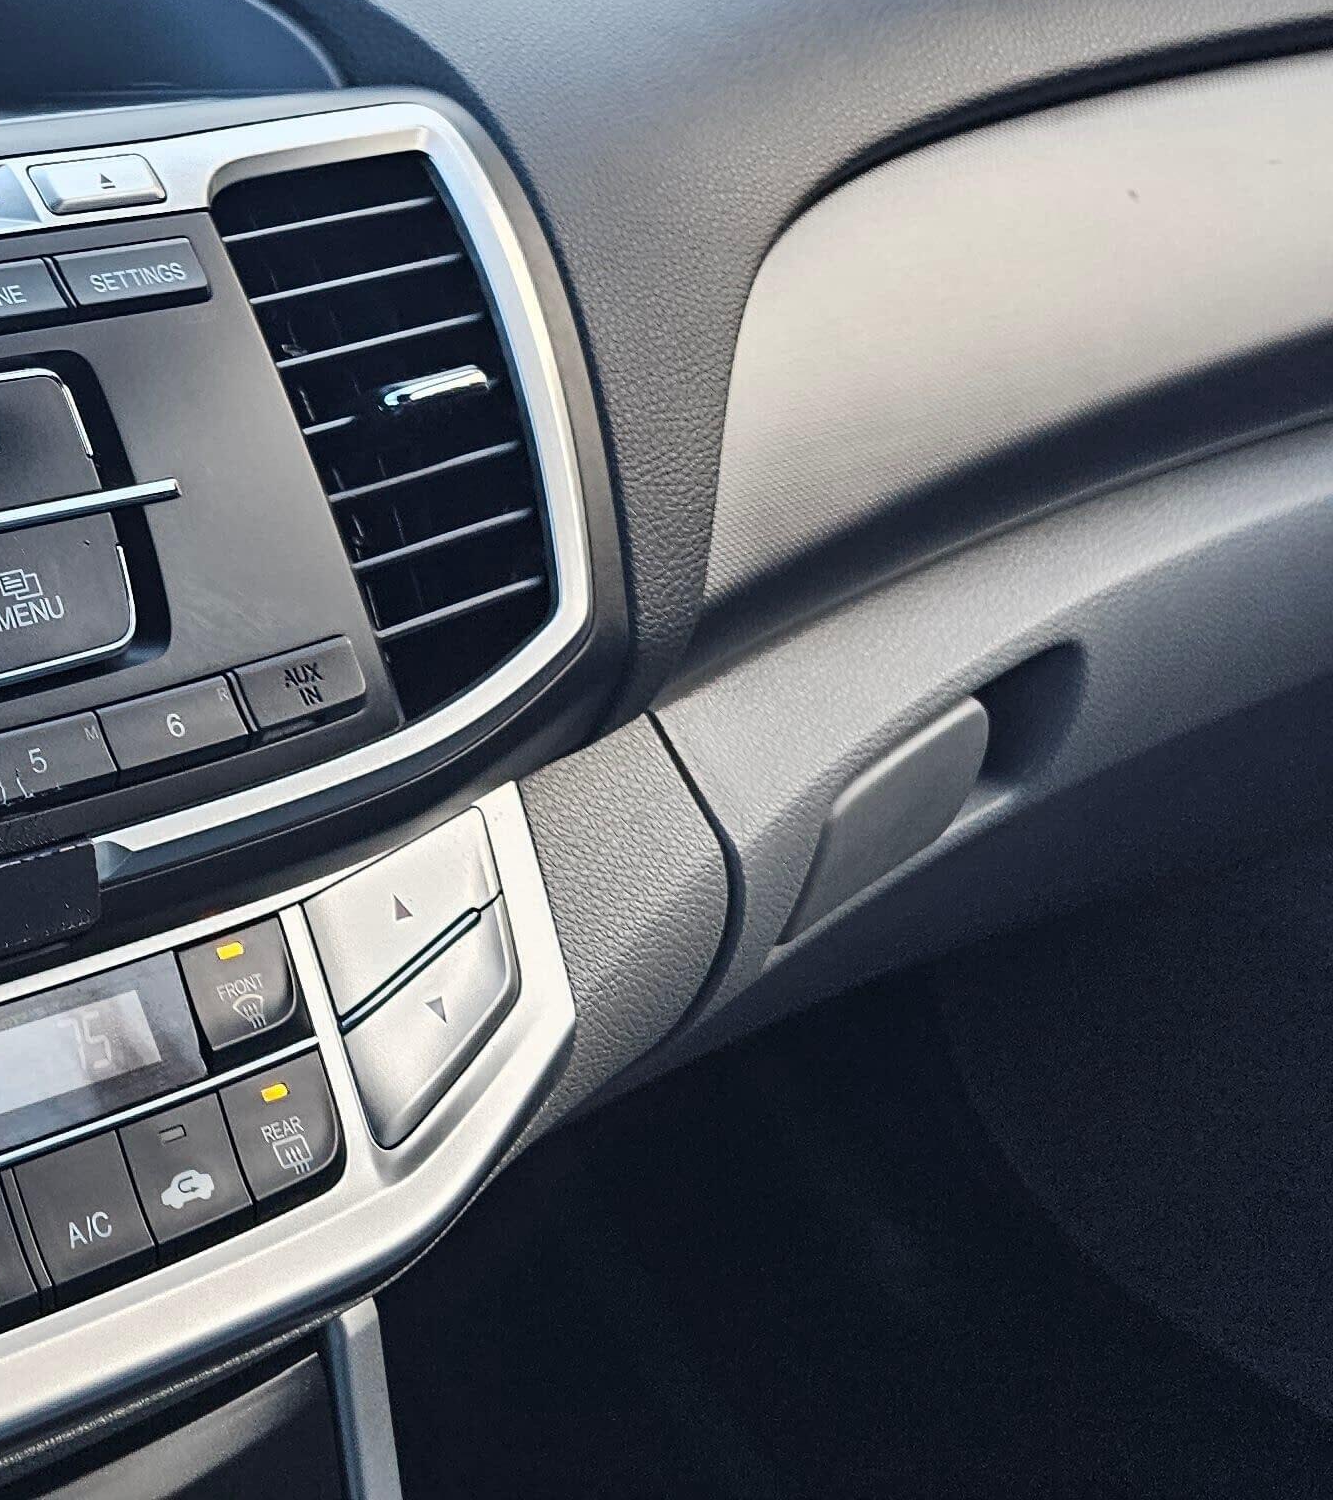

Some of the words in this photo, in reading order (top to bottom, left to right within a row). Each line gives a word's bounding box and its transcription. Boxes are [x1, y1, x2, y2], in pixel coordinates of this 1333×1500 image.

[88, 262, 186, 293] SETTINGS
[283, 662, 322, 687] AUX
[299, 686, 322, 706] IN
[166, 713, 186, 738] 6
[28, 747, 48, 774] 5
[216, 972, 264, 1001] FRONT
[260, 1115, 306, 1144] REAR
[68, 1211, 113, 1249] A/C
